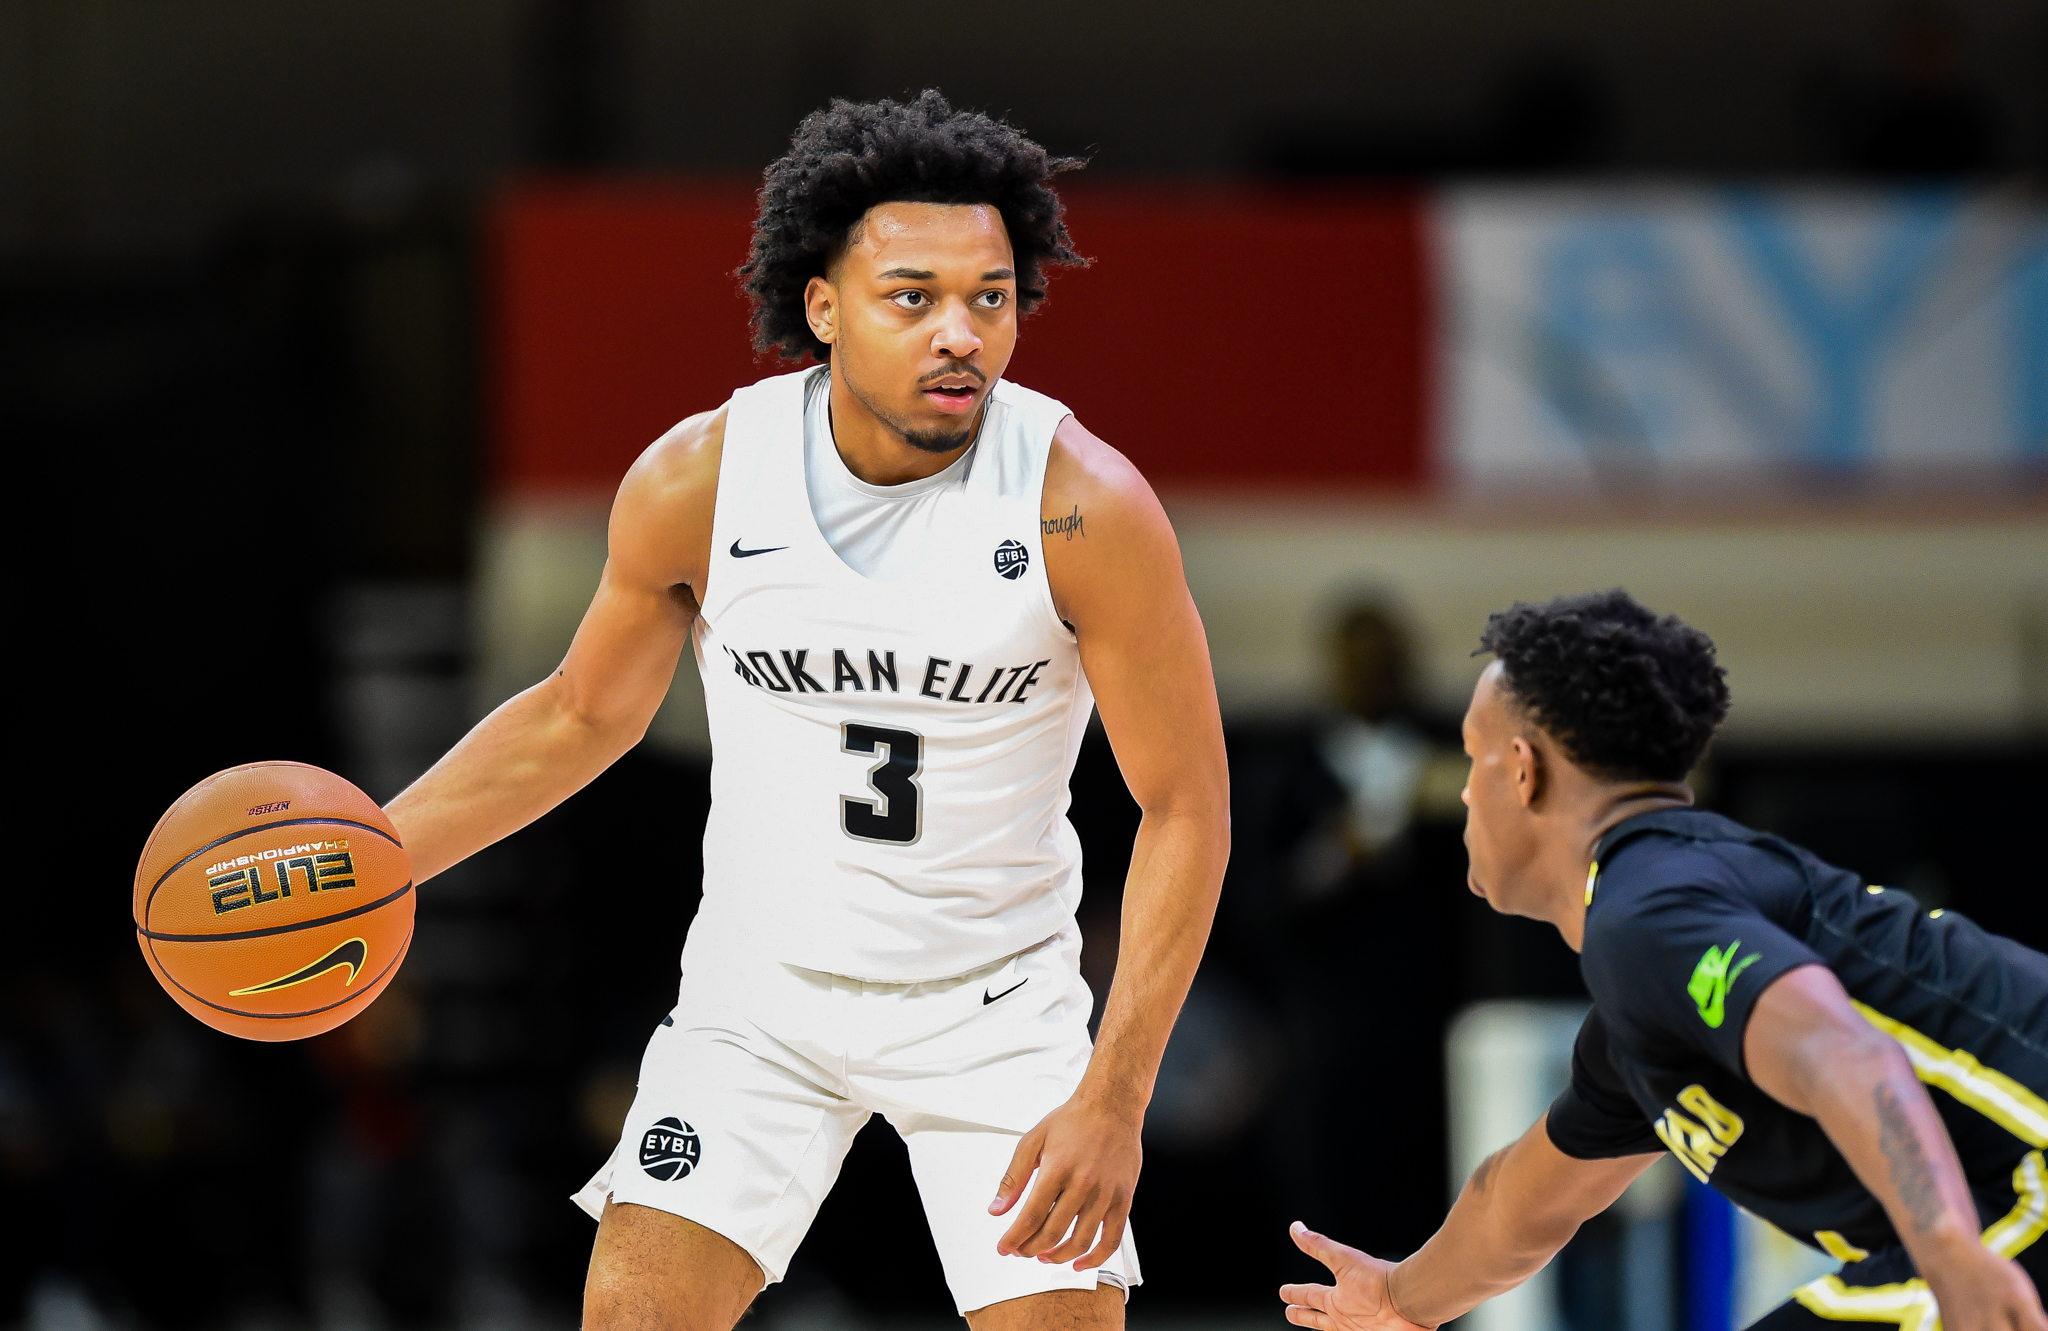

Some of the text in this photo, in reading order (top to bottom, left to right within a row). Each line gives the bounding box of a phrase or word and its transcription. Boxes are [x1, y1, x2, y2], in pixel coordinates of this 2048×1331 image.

[997, 549, 1027, 563] EYBL
[919, 655, 1052, 704] ELITE
[840, 719, 925, 847] 3
[205, 839, 349, 876] CHAMPIONSHIP
[208, 851, 356, 916] ELITE
[645, 1134, 696, 1157] EYBL
